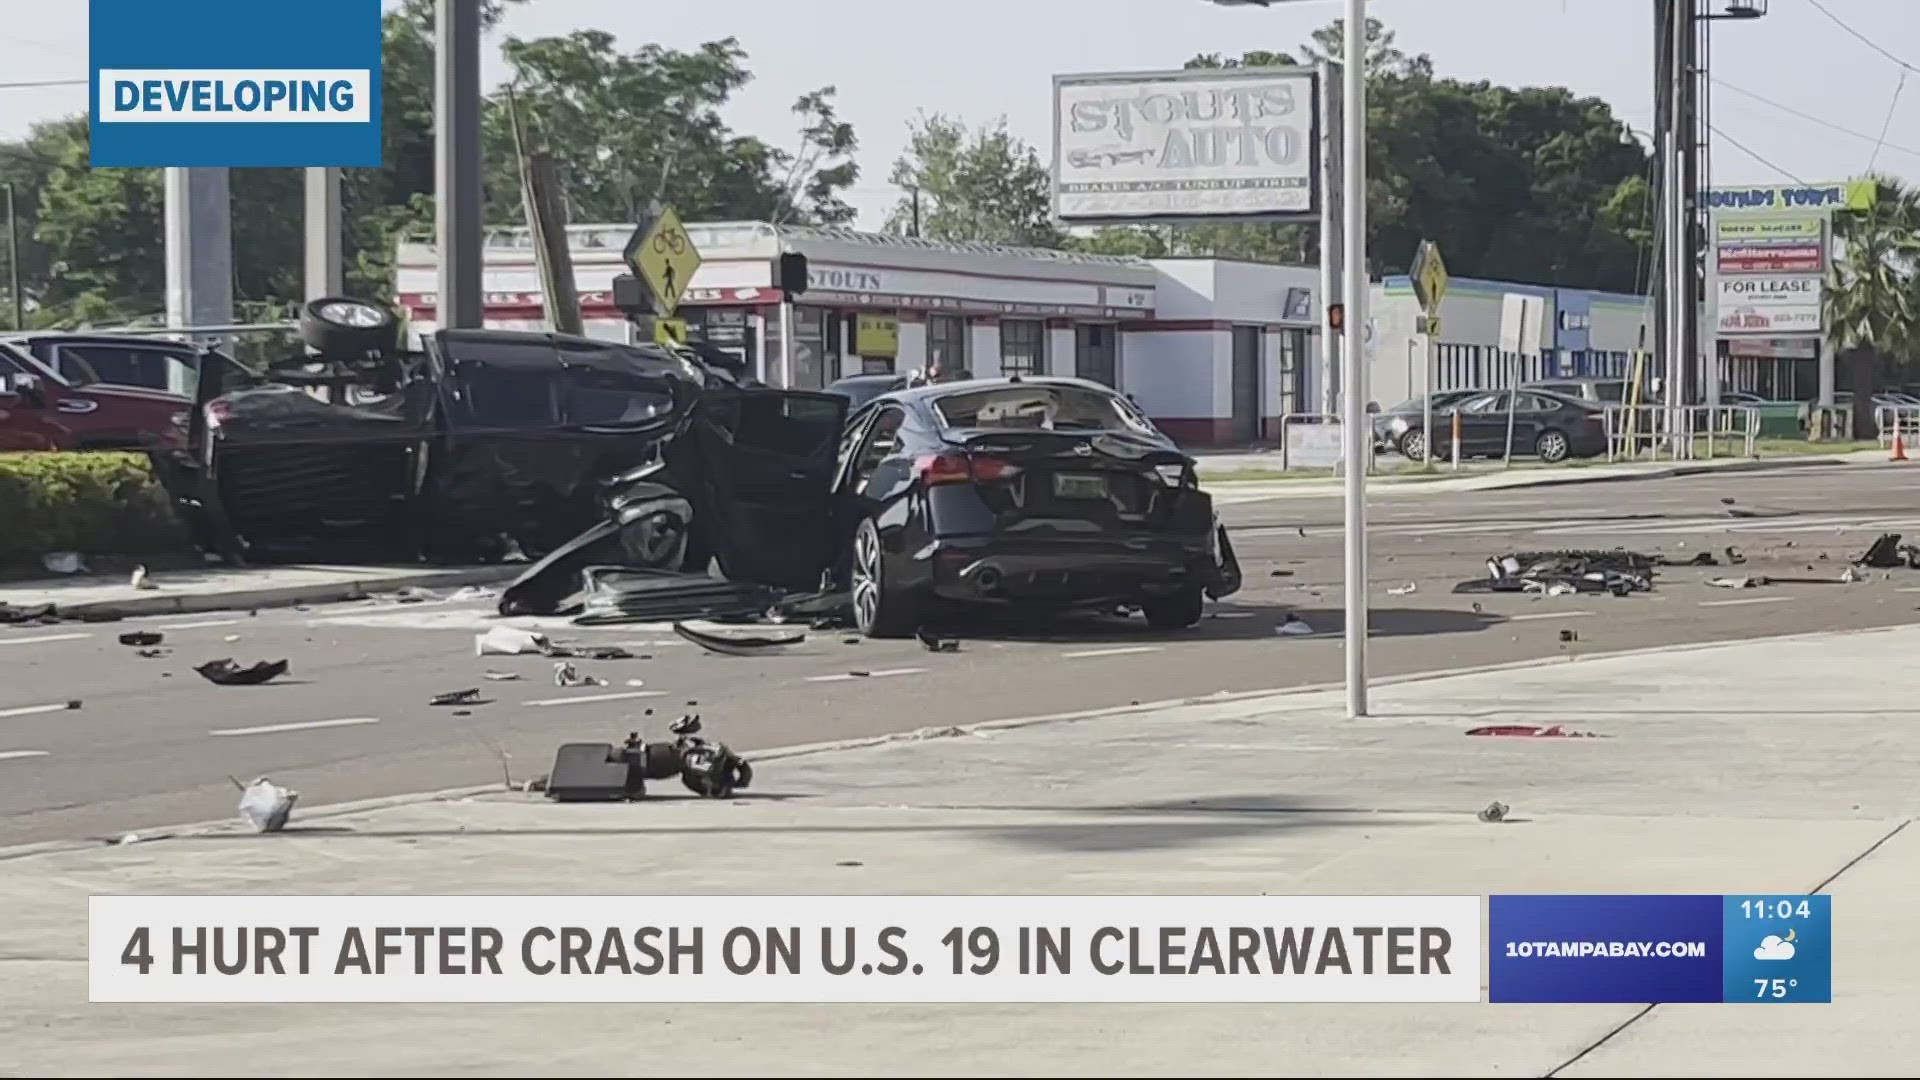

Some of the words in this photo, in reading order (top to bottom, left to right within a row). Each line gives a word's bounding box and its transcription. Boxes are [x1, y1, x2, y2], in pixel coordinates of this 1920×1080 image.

[1070, 84, 1296, 141] STOUTS
[1156, 125, 1303, 169] AUTO
[1068, 182, 1131, 193] BRAKES
[1254, 178, 1301, 188] TIRES
[1781, 186, 1839, 206] TOWN
[1723, 281, 1756, 293] FOR
[1760, 280, 1812, 293] LEASE
